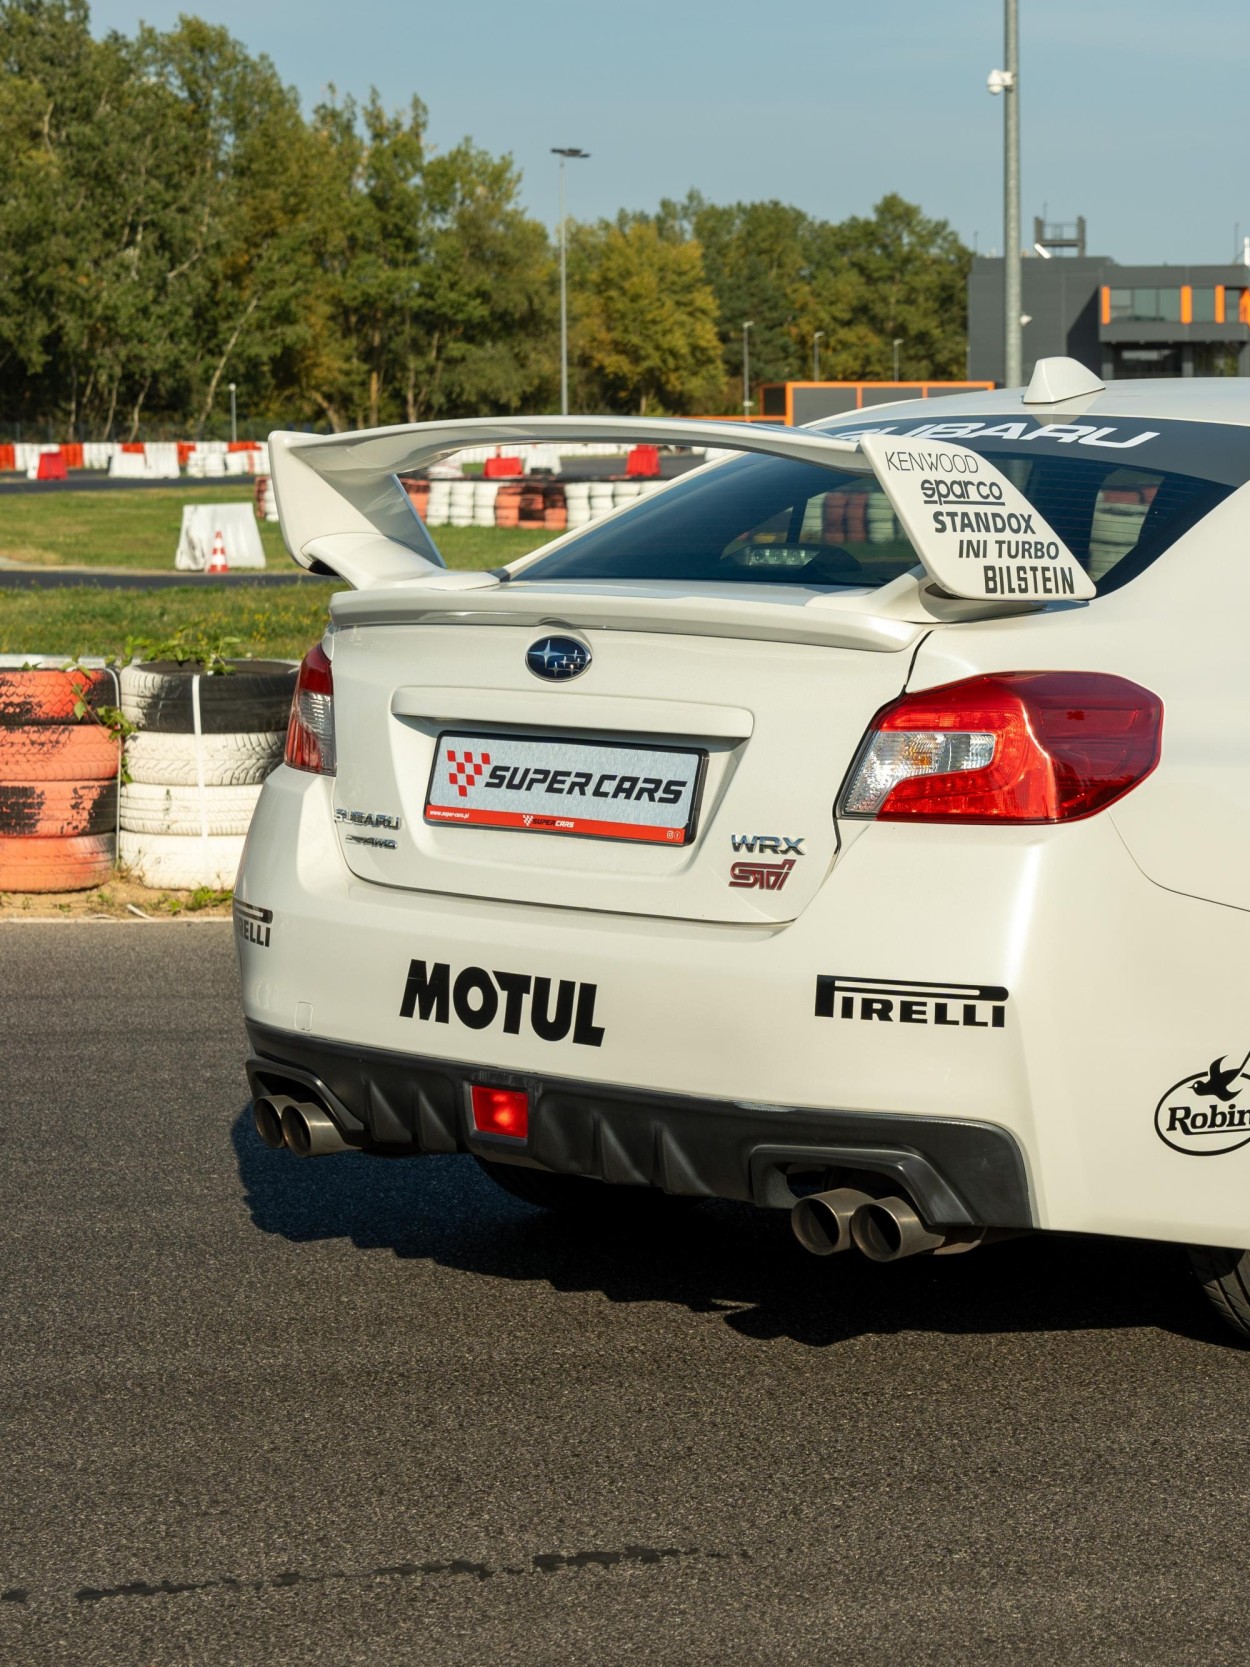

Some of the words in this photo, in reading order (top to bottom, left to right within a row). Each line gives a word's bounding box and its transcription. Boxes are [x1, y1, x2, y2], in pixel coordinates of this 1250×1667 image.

[885, 451, 979, 474] KENWOOD
[920, 479, 1004, 505] sparco
[932, 511, 1036, 535] STANDOX
[958, 540, 988, 559] INI
[995, 540, 1060, 560] TURBO
[983, 565, 1075, 595] BILSTEIN
[334, 808, 401, 830] SUBARU
[731, 834, 806, 855] WRX
[399, 959, 605, 1048] MOTUL
[814, 974, 1009, 1028] PIRELLI
